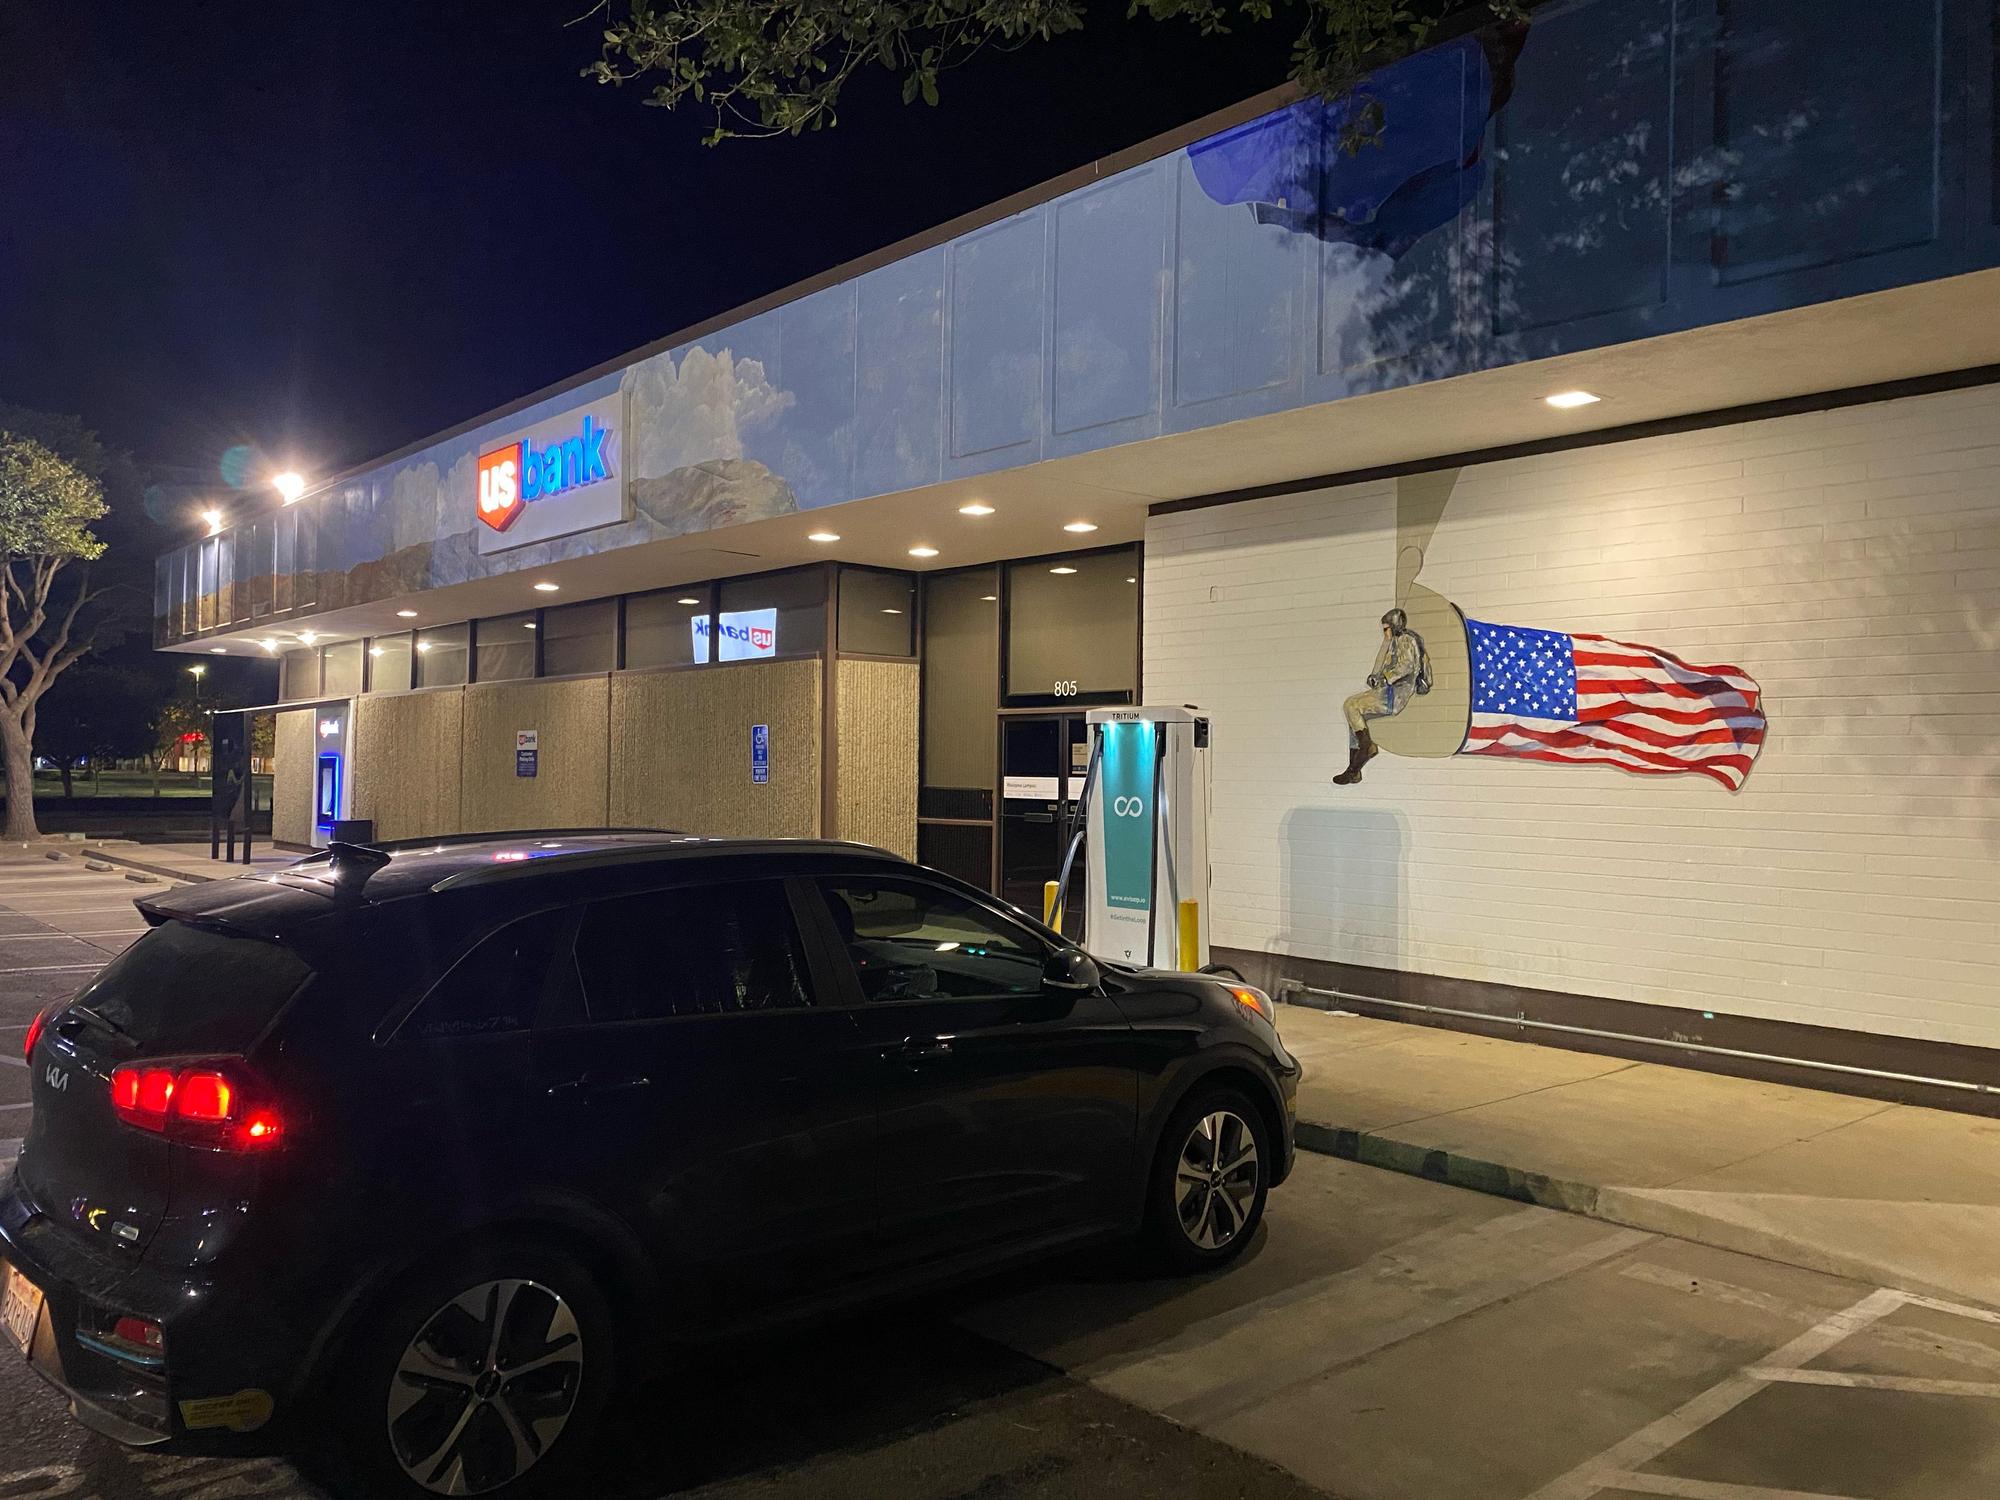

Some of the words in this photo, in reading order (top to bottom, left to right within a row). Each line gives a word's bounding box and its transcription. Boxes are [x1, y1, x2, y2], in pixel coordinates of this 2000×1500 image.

[481, 460, 516, 513] us
[522, 415, 607, 501] bank
[1054, 681, 1077, 697] 805
